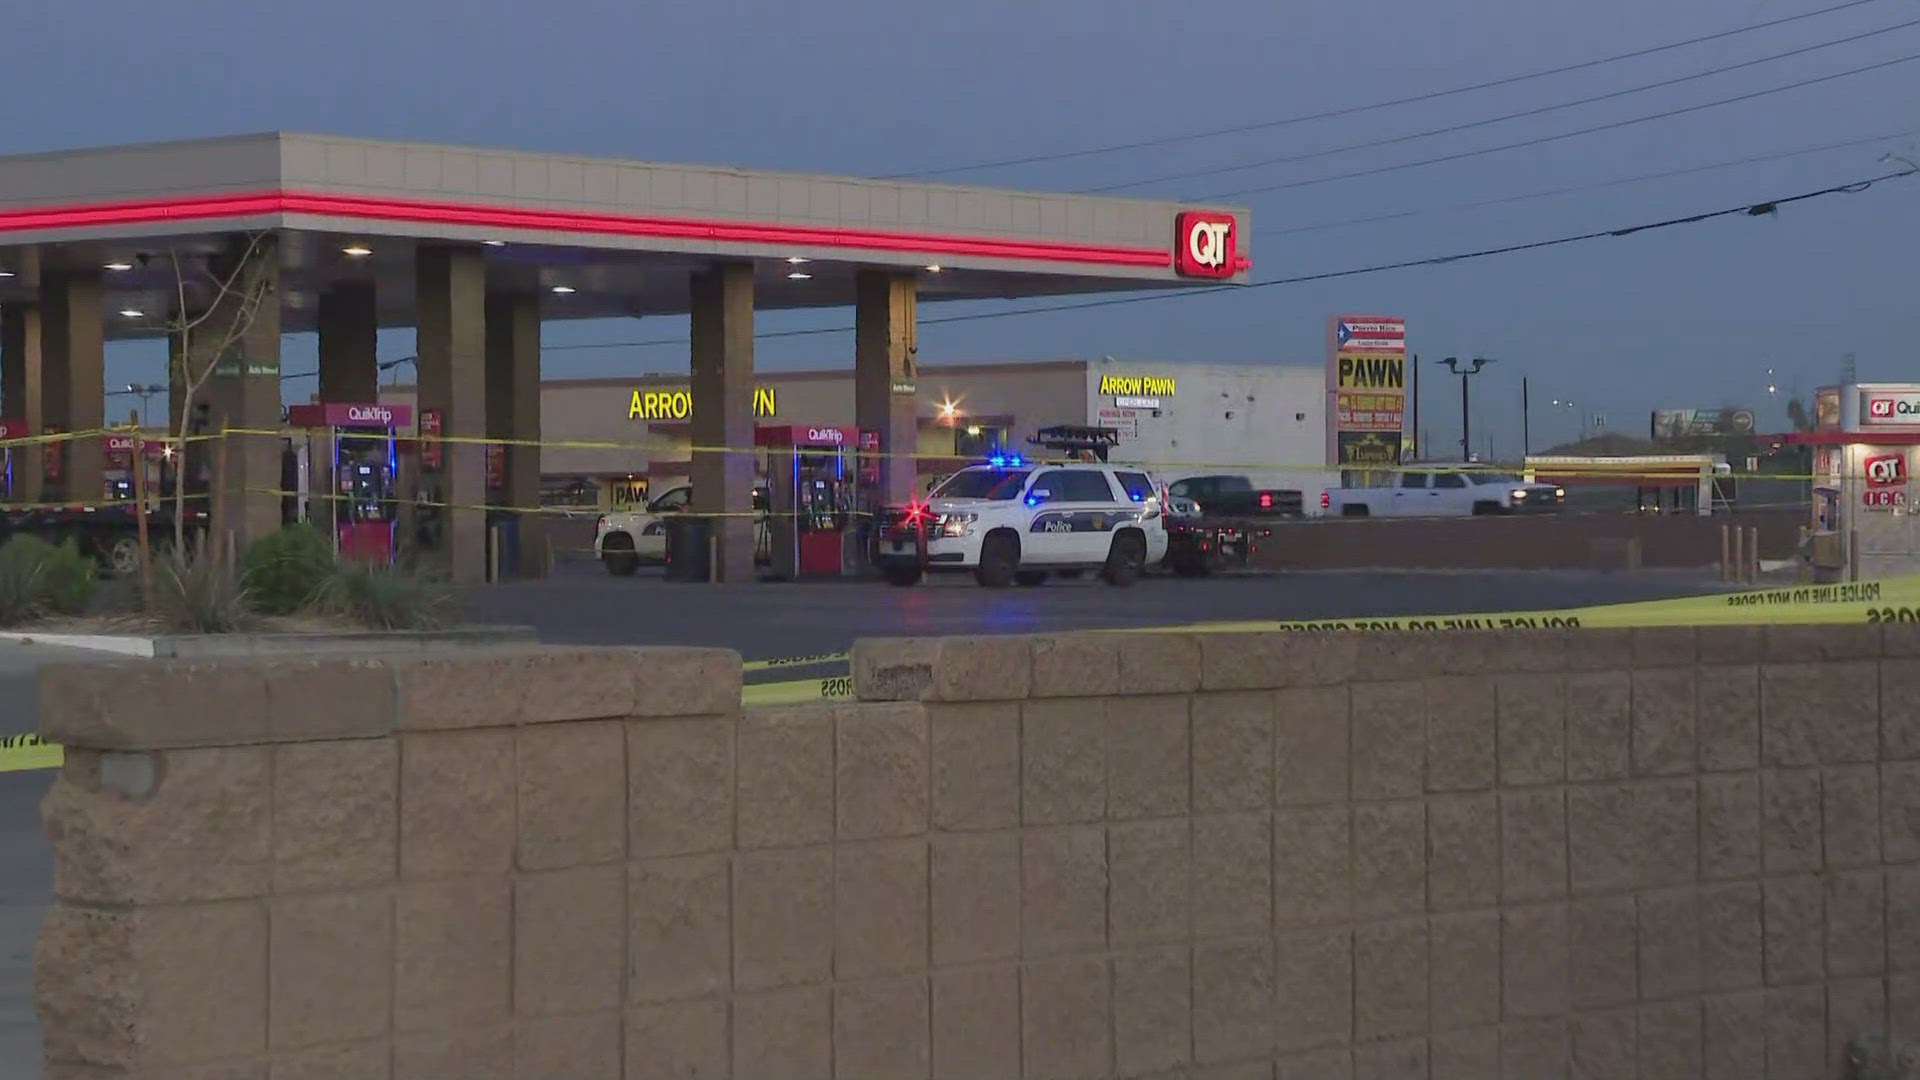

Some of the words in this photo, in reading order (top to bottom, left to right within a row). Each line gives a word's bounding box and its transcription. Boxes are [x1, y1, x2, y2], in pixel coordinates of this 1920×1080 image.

[1190, 221, 1231, 268] QT
[1338, 358, 1403, 388] PAWN
[1100, 375, 1142, 396] ARROW
[1143, 376, 1175, 397] PAWN
[349, 407, 392, 424] QuikTrip
[1872, 401, 1891, 416] QT
[808, 428, 843, 443] QuikTrip
[1868, 458, 1900, 483] QT
[1045, 521, 1072, 533] Police
